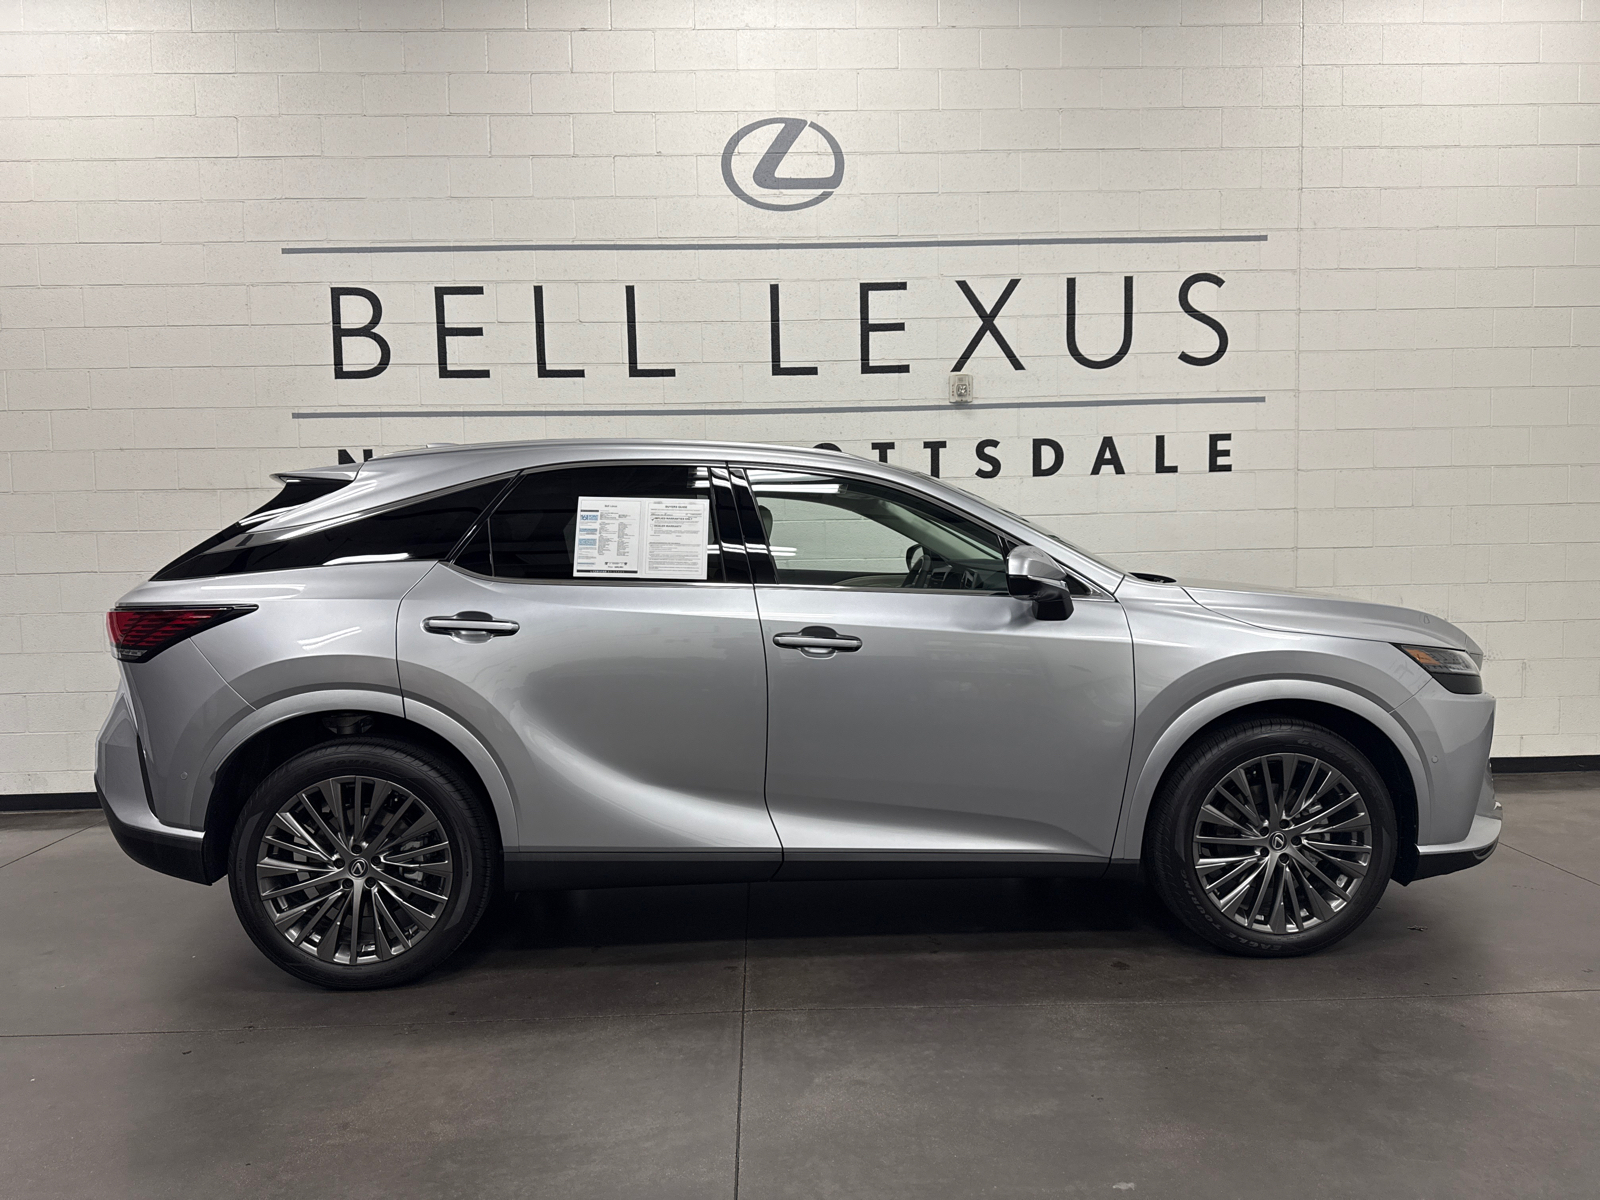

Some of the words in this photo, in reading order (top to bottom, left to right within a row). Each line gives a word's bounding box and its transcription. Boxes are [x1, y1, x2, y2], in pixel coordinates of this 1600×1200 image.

[330, 284, 676, 379] BELL
[769, 272, 1229, 376] LEXUS
[812, 433, 1233, 479] TTSDALE
[1226, 931, 1282, 951] EAGLE
